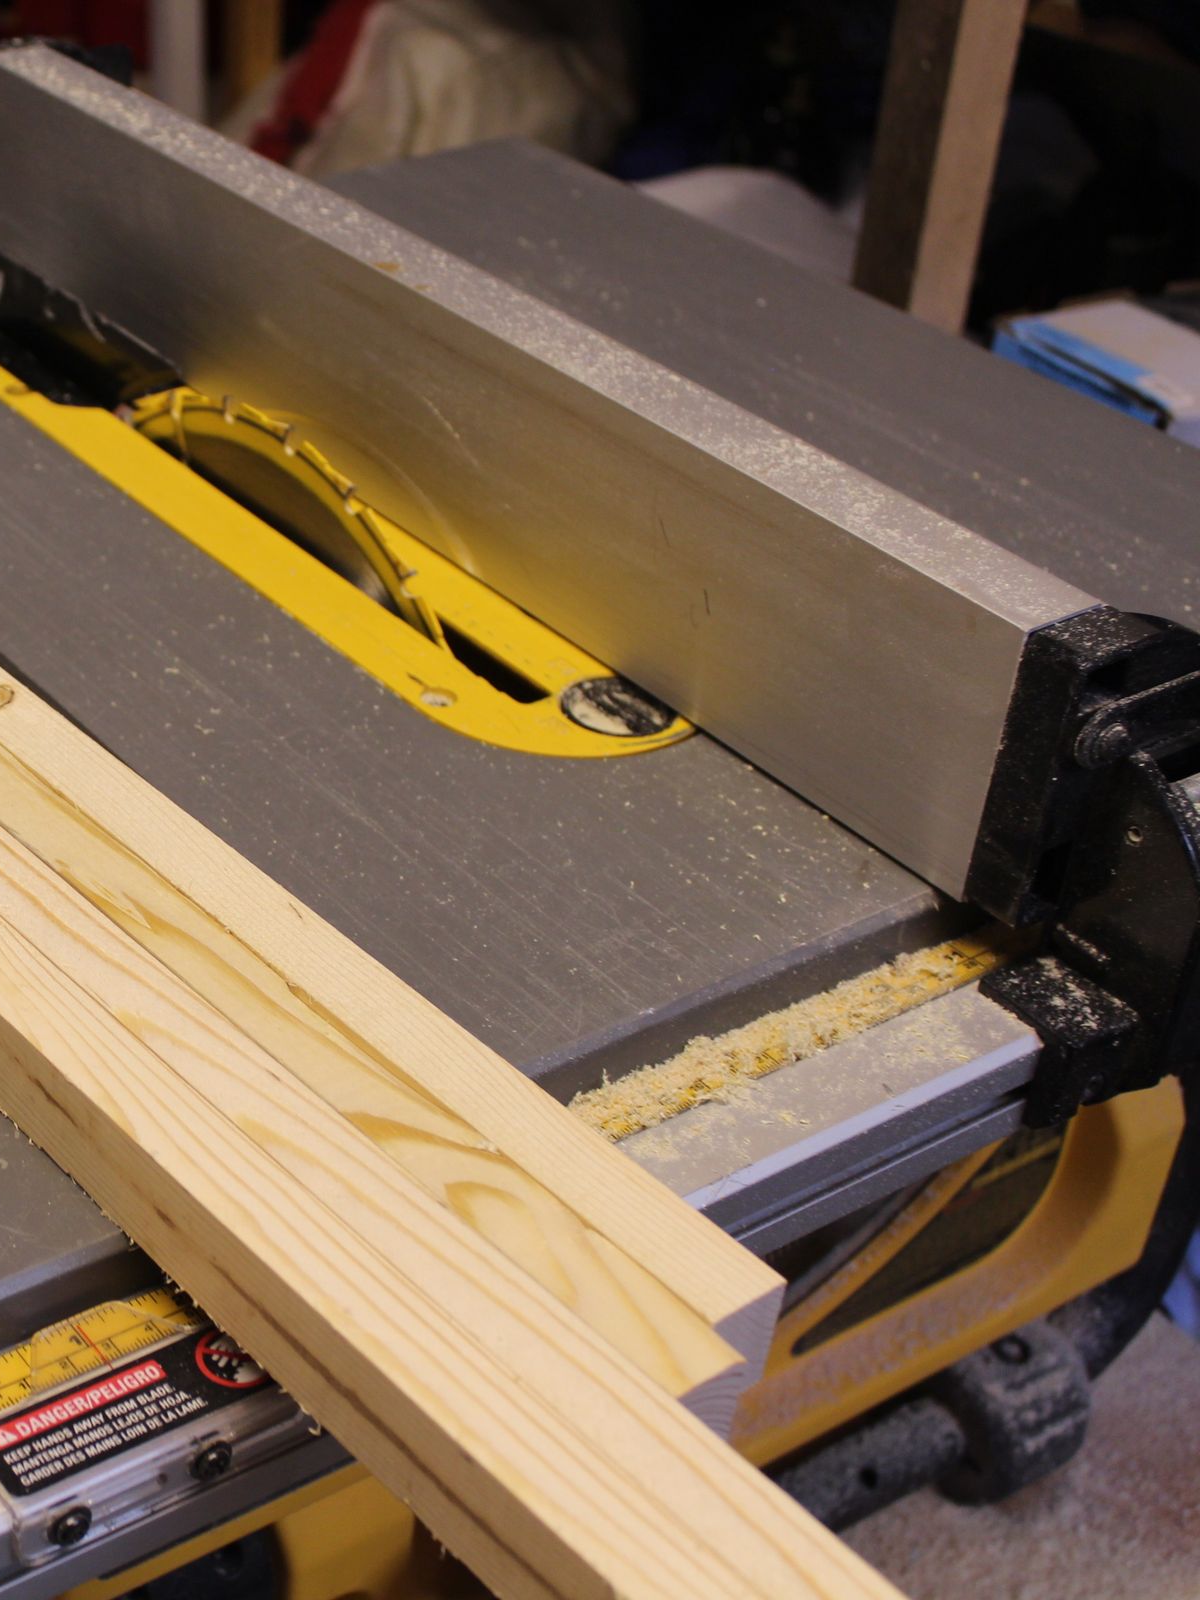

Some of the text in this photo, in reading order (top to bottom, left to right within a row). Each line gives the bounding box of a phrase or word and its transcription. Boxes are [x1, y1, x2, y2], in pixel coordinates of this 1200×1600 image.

[3, 1382, 176, 1466] KEEP HANDS AWAY FROM BLADE.
[11, 1390, 192, 1477] MANTENGA MANOS LEJOS DE HOJA.
[15, 1364, 161, 1438] DANGER/PELIGRO
[20, 1396, 209, 1487] GARDER DES MAINS LOIN DE LA LAME.
